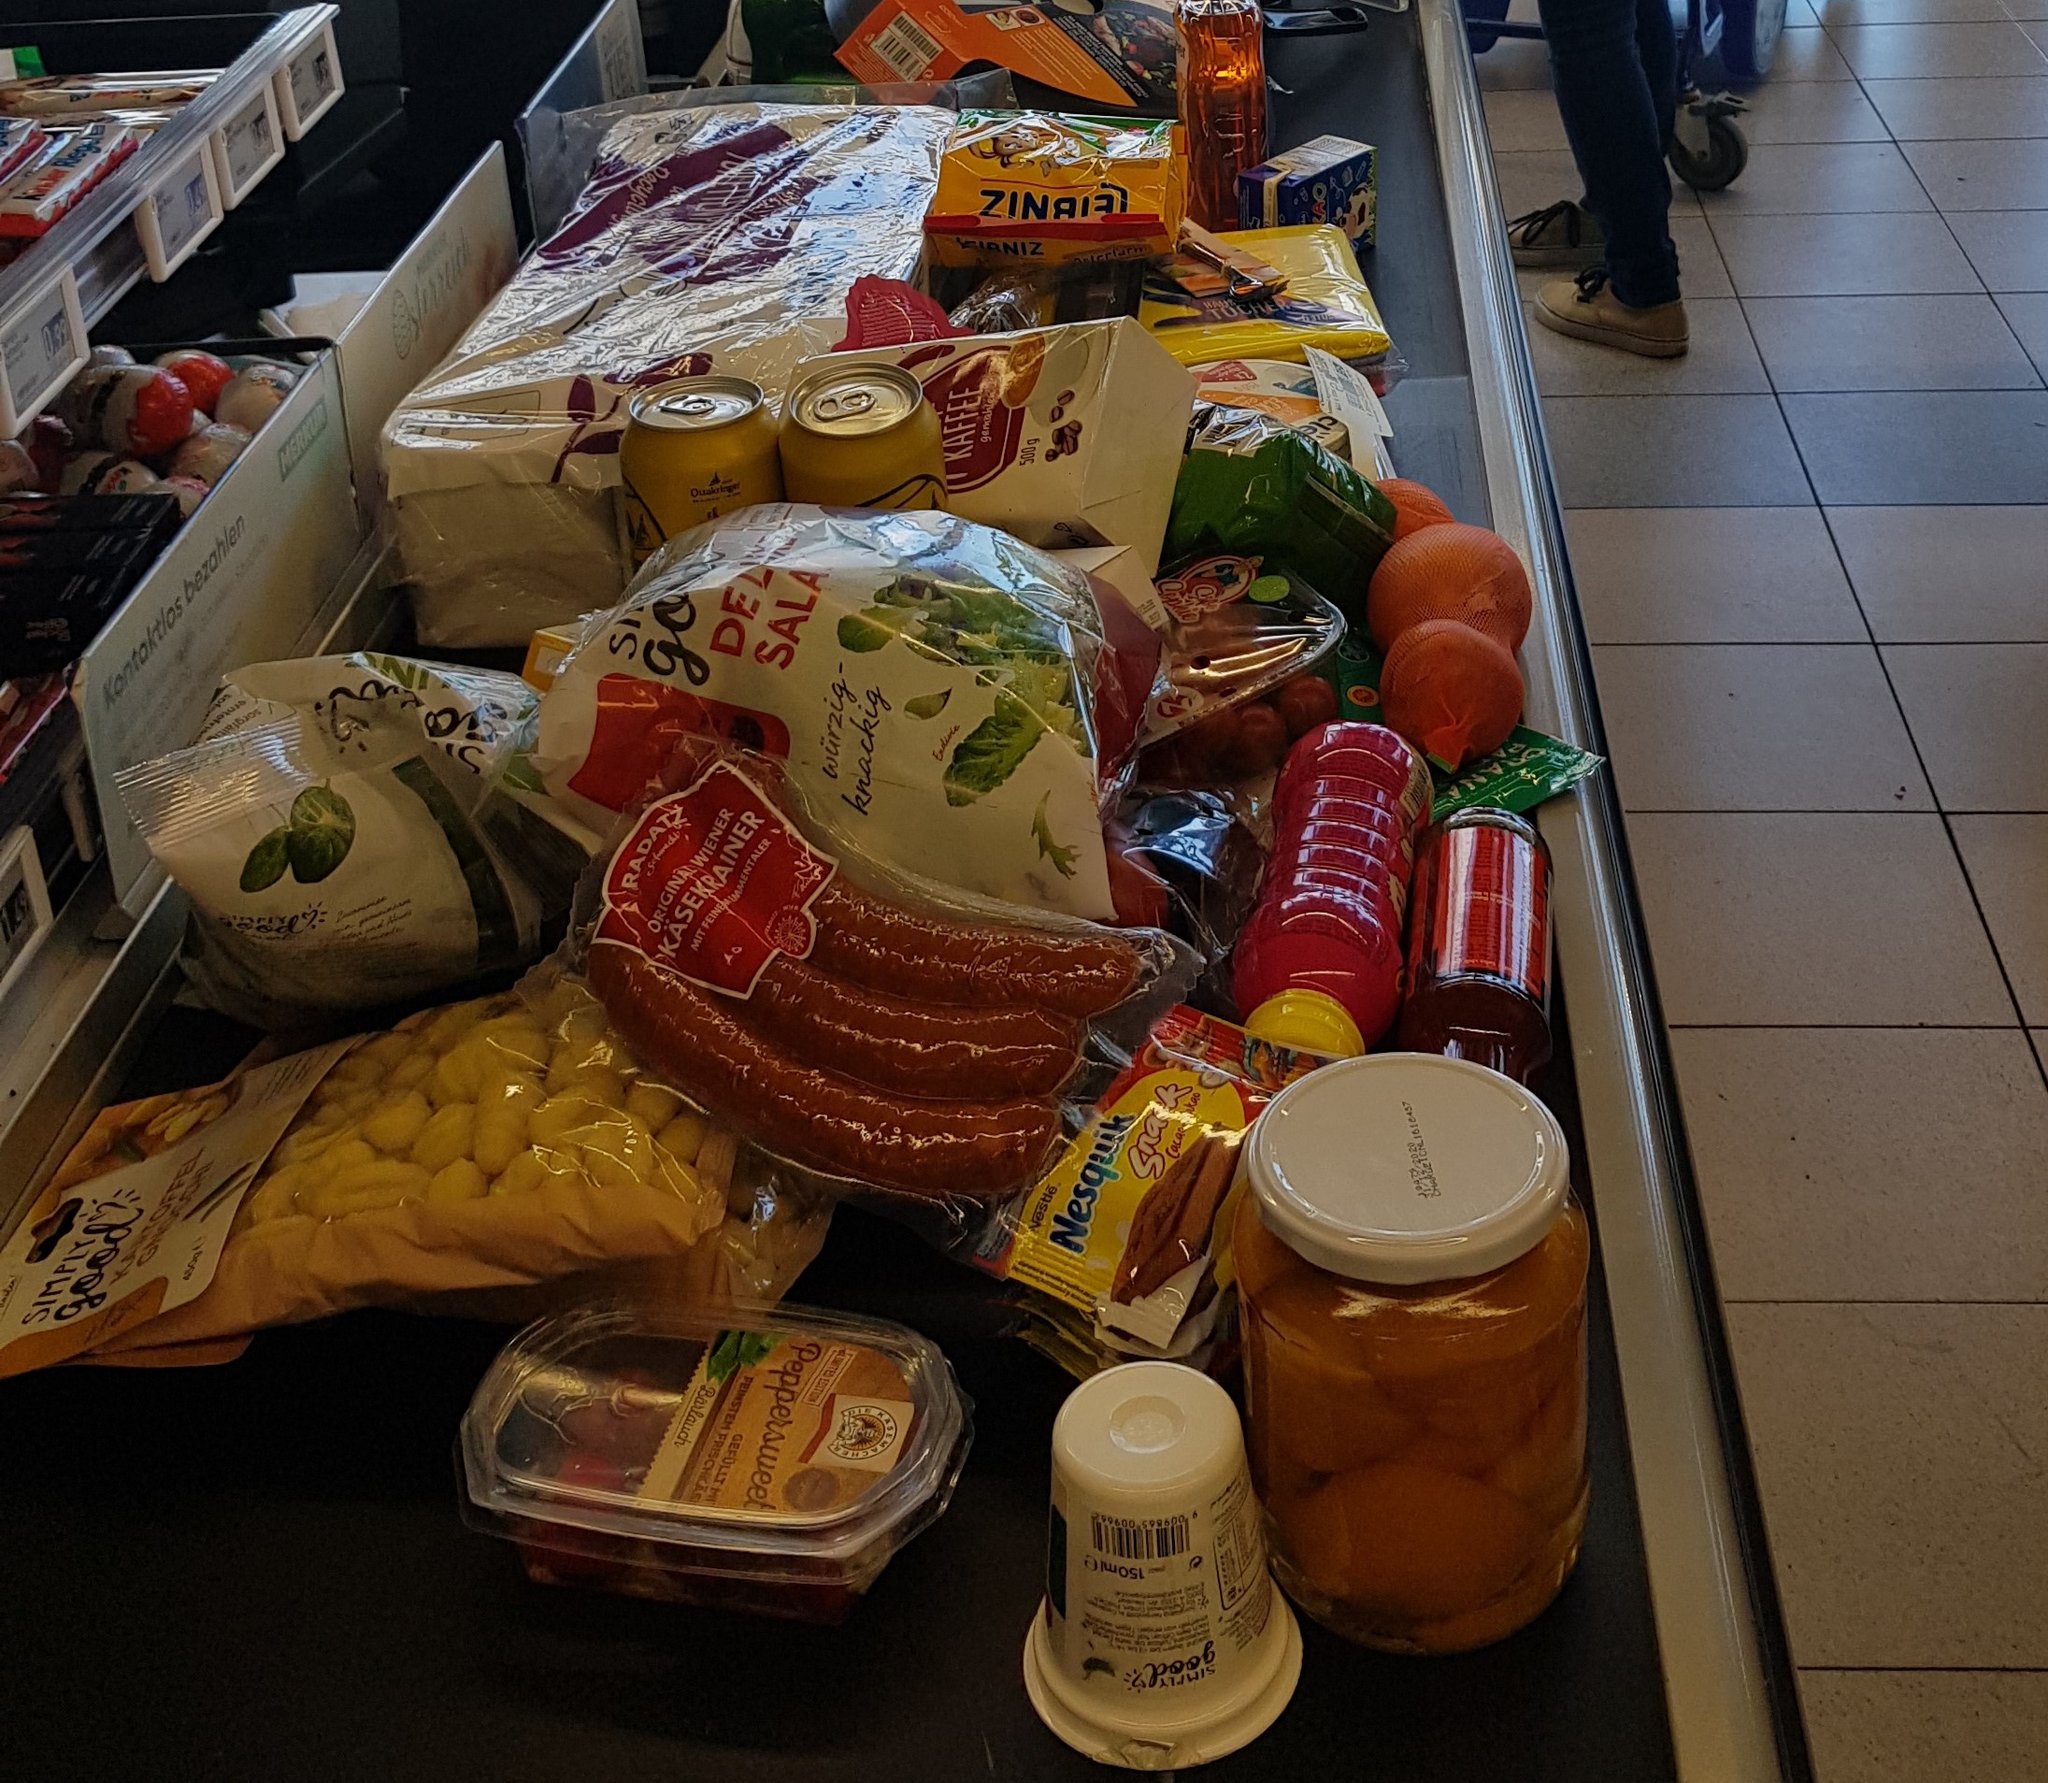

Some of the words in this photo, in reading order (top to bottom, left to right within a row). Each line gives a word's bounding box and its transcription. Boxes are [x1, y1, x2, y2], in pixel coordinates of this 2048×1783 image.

[978, 181, 1129, 221] LEIBNIZ
[942, 387, 983, 463] KAFFEE
[1019, 446, 1037, 467] 500
[103, 595, 185, 707] Kontaktlos
[183, 514, 246, 605] bezahlen
[754, 569, 830, 671] SALA
[820, 661, 858, 780] würzig-
[840, 685, 893, 817] knackig
[620, 803, 689, 891] RADATZ
[646, 864, 698, 934] ORIGINAL
[690, 806, 735, 868] WIENER
[657, 810, 766, 959] KÄSEKRAINER
[689, 924, 708, 952] MIT
[1049, 1113, 1139, 1255] Nesquik
[21, 1239, 97, 1325] SIMPLY
[54, 1207, 144, 1322] good
[1100, 1559, 1145, 1580] 150ml
[1142, 1640, 1216, 1689] good
